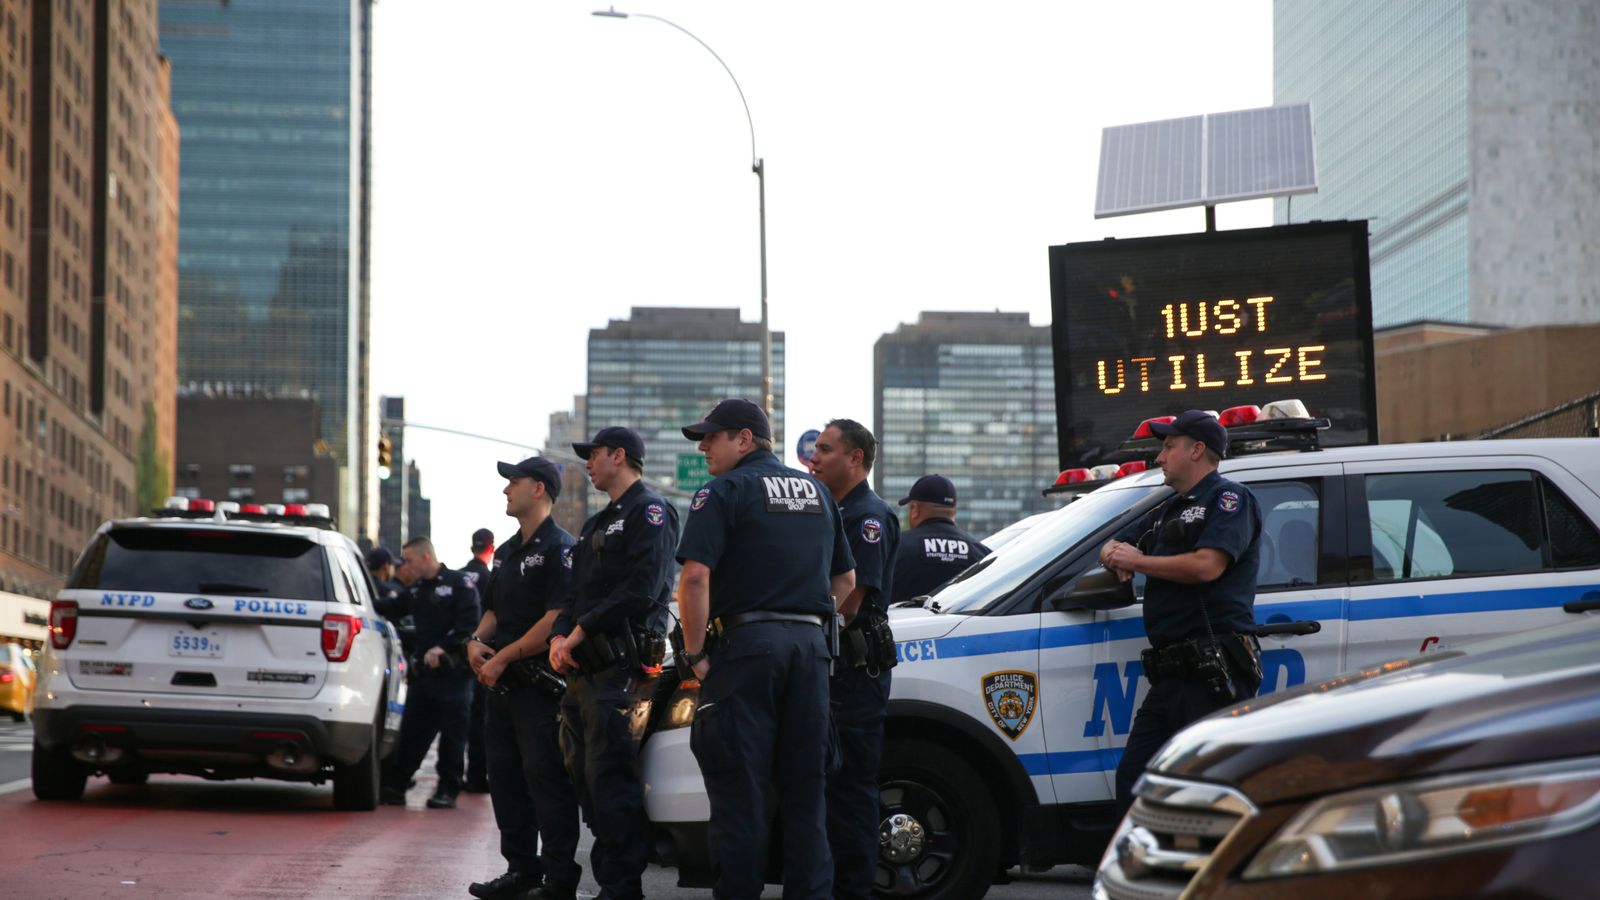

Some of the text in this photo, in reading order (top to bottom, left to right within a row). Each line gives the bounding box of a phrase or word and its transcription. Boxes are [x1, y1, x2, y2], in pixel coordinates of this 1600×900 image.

[1097, 345, 1327, 394] UTILIZE
[763, 477, 817, 499] NYPD
[787, 503, 805, 511] GROUP
[795, 498, 820, 506] RESPONSE
[923, 538, 969, 555] NYPD
[101, 593, 155, 607] NYPD
[233, 599, 308, 616] POLICE
[173, 636, 209, 651] 5539
[895, 640, 935, 663] ICE
[994, 674, 1025, 683] POLICE
[985, 681, 1035, 695] DEPARTMENT
[988, 701, 1007, 729] CITY OF
[1016, 696, 1036, 731] NEW YORK
